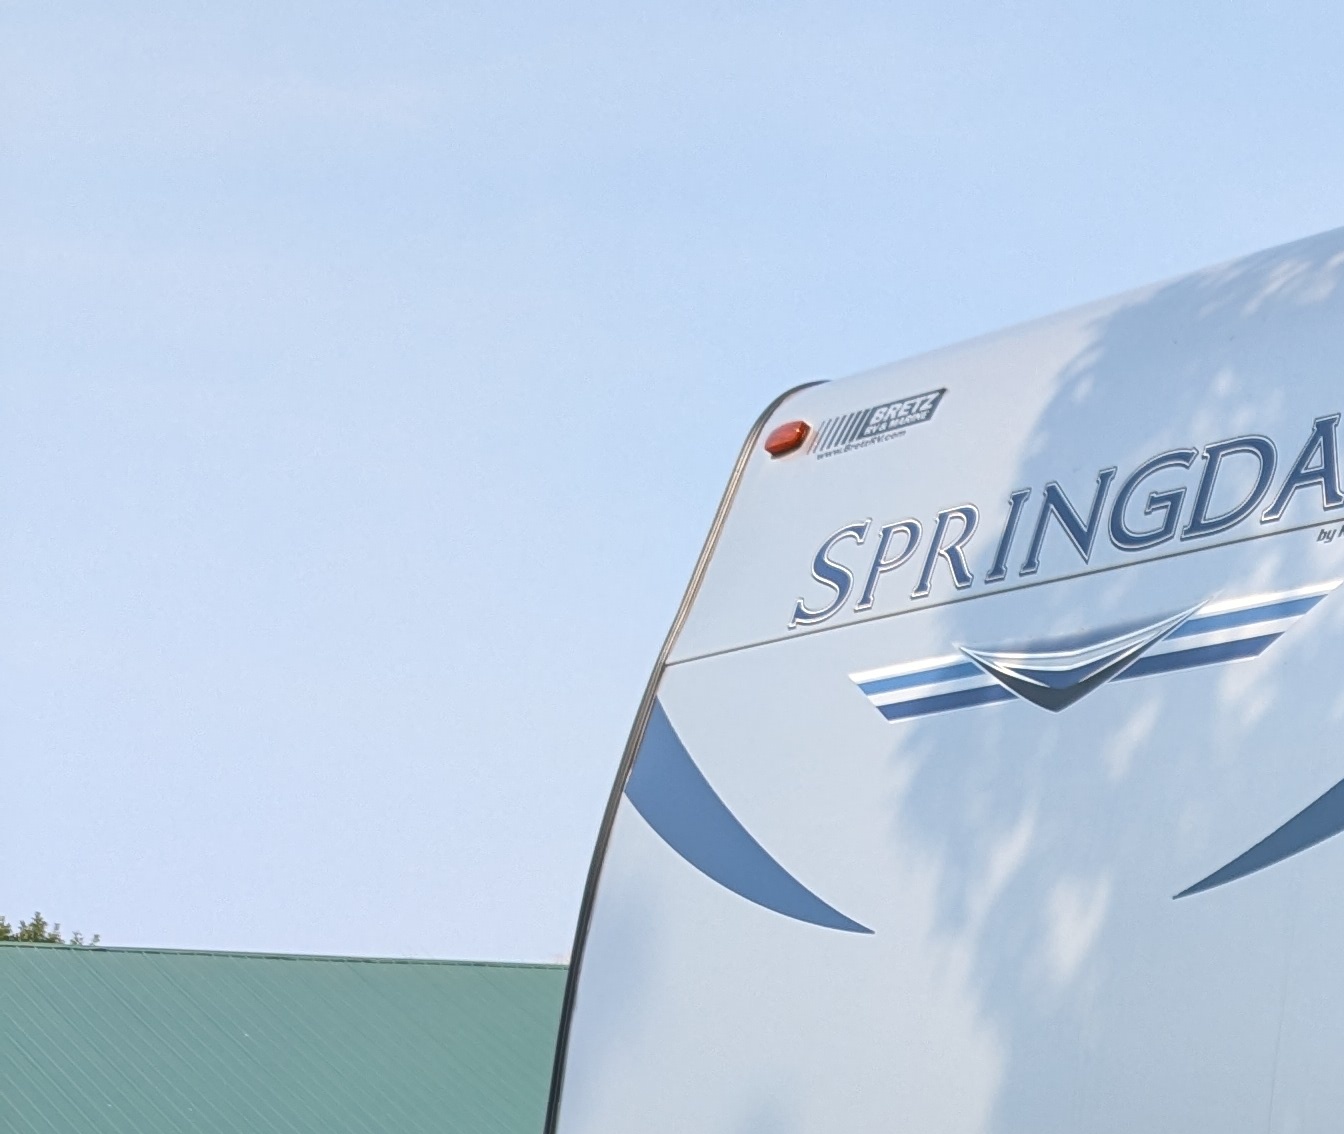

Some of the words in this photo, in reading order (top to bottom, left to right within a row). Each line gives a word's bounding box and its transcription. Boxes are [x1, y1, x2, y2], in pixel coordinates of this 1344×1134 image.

[870, 391, 940, 423] BRETZ
[864, 422, 879, 436] RV
[1316, 528, 1337, 543] by
